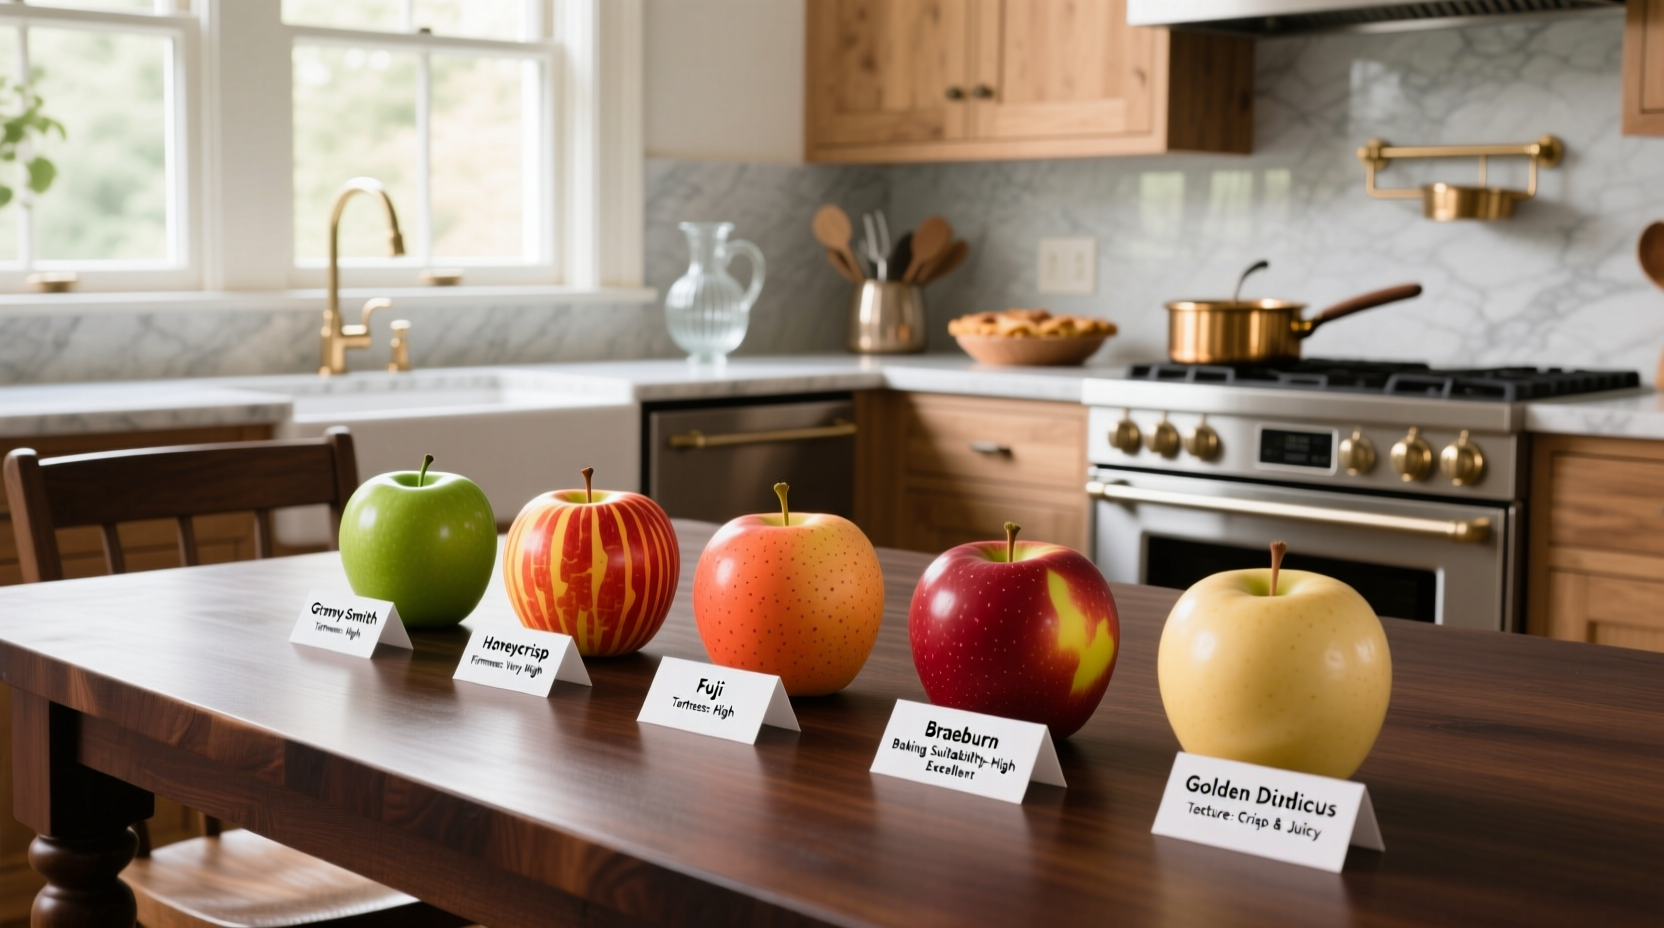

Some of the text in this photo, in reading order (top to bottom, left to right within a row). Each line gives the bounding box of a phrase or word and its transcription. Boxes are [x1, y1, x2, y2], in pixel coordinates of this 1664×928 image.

[345, 608, 377, 625] Smith
[696, 678, 725, 700] Fuji
[713, 704, 734, 720] High
[925, 720, 999, 749] Braeburn
[892, 738, 927, 758] Baking
[1186, 775, 1250, 801] Golden
[1287, 821, 1322, 842] Juicy
